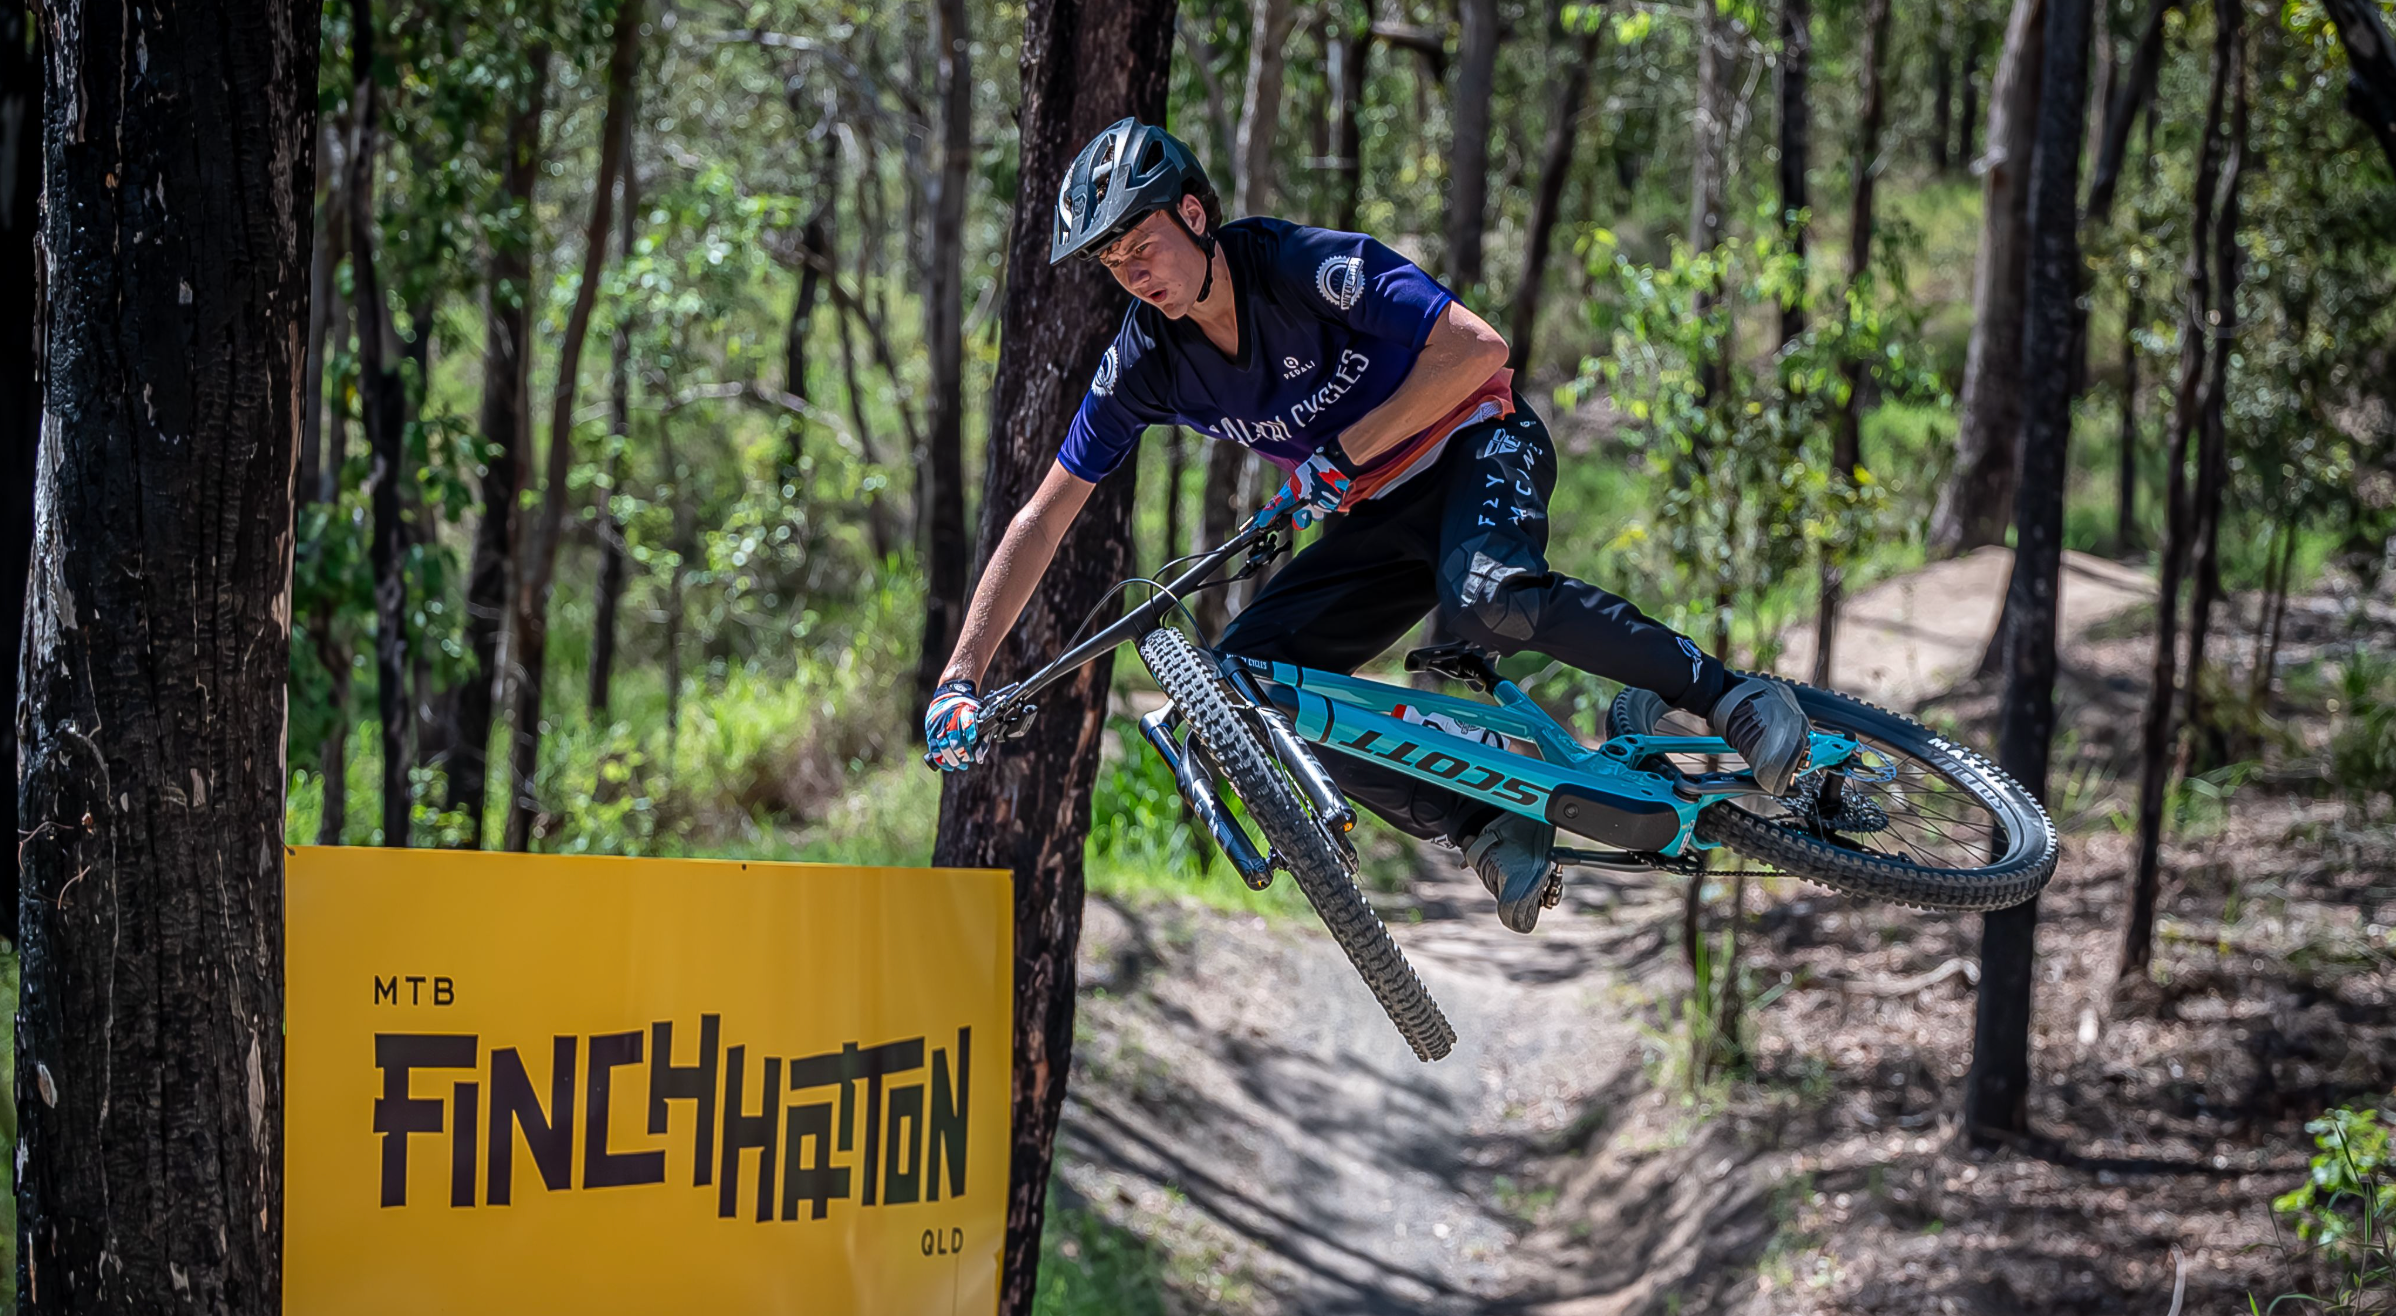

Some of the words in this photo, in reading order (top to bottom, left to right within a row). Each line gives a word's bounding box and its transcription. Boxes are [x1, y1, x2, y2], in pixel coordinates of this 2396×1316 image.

[1284, 360, 1316, 380] PEDALI
[1478, 473, 1505, 526] FLY
[1337, 729, 1552, 806] SCOTT
[1927, 737, 2011, 794] MAXXIS
[373, 975, 456, 1006] MTB
[920, 1227, 965, 1256] QLD
